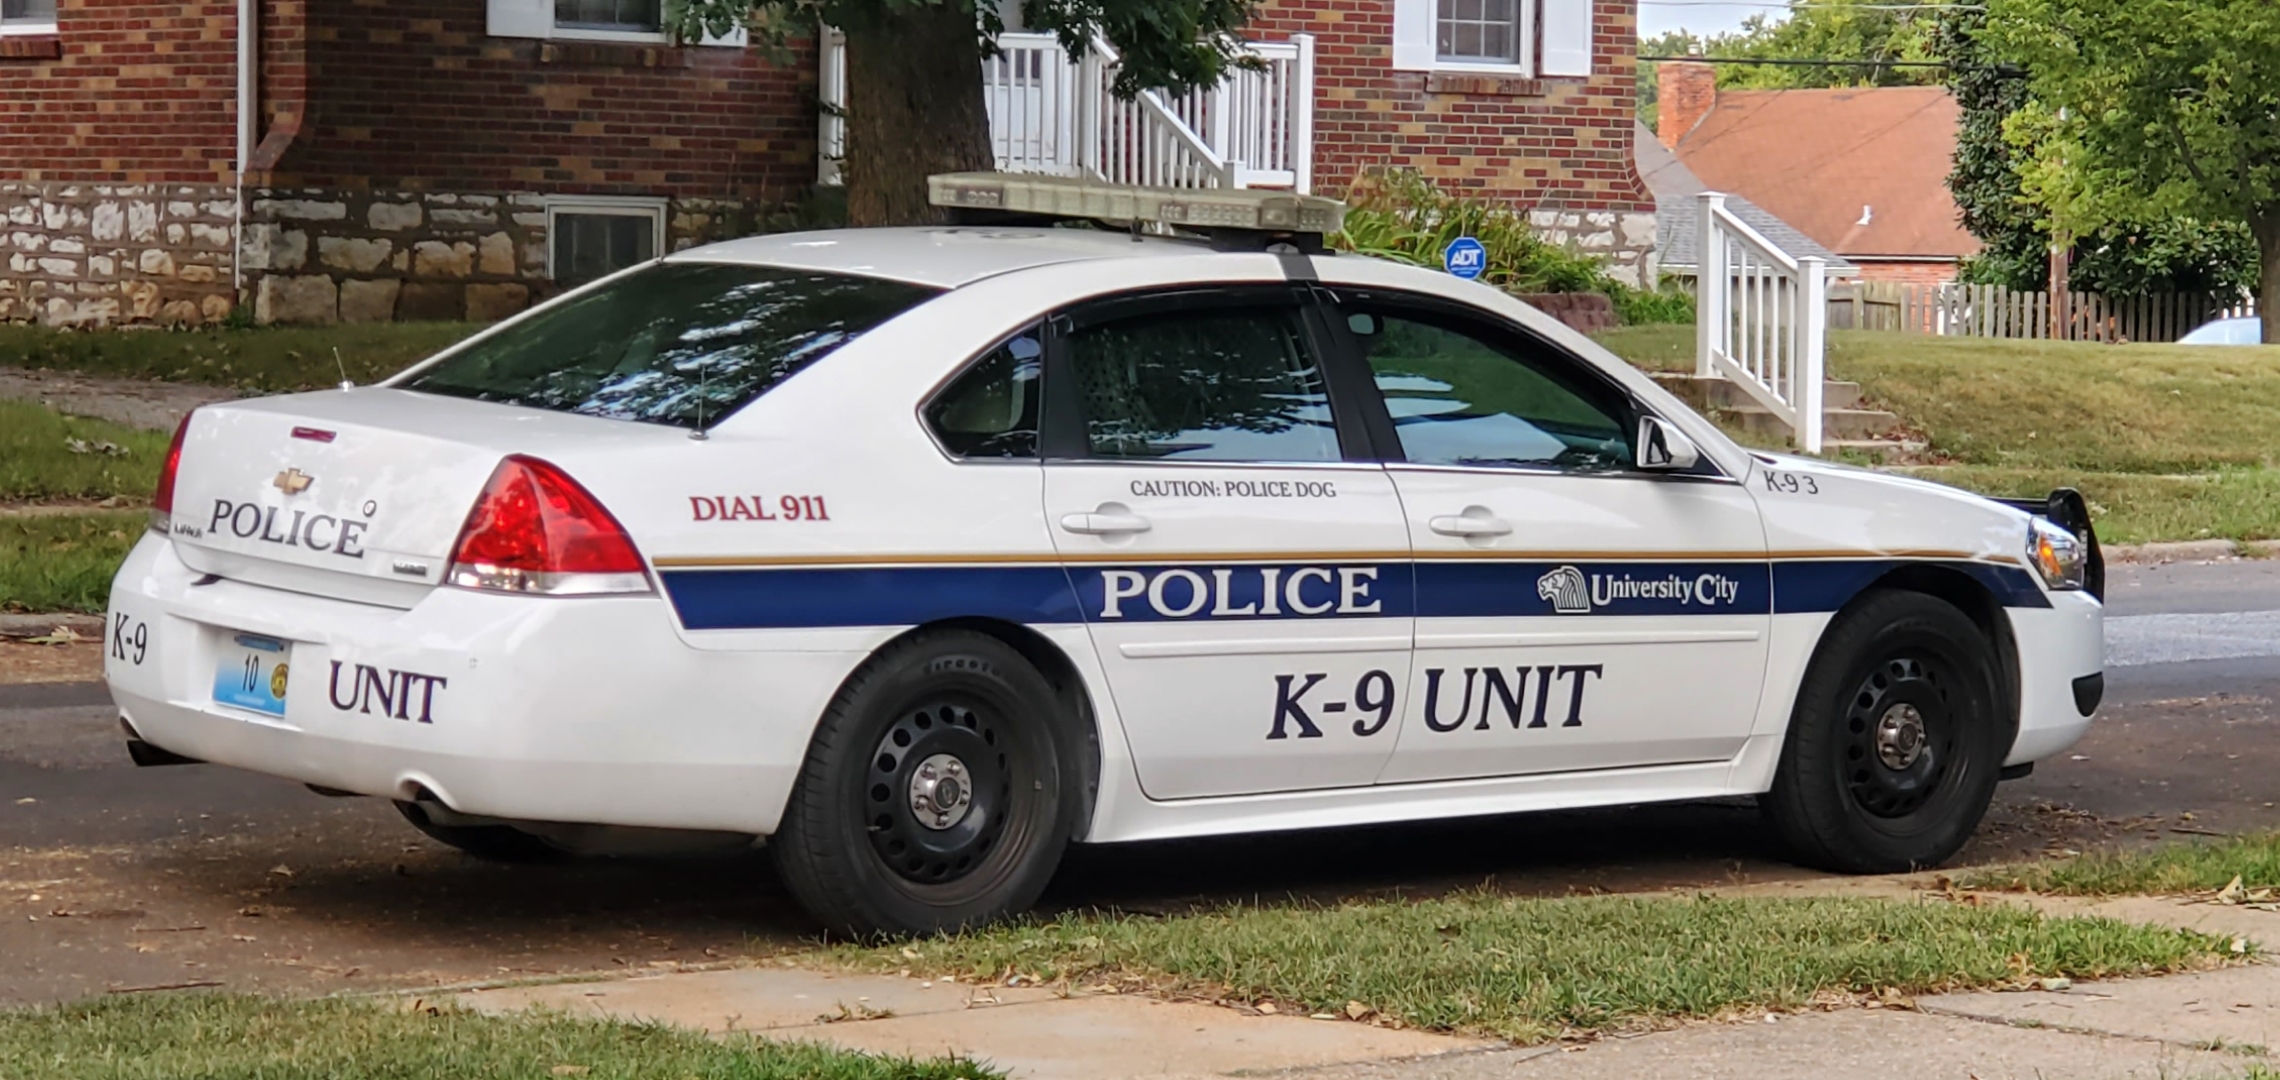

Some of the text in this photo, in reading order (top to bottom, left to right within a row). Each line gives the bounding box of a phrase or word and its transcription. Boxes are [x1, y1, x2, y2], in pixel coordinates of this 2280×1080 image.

[1450, 248, 1482, 267] ADT
[1130, 480, 1337, 498] CAUTION: POLICE DOG
[1763, 470, 1819, 495] K-9 3
[688, 494, 831, 521] DIAL 911
[207, 498, 368, 559] POLICE
[1099, 566, 1381, 618] POLICE
[1591, 573, 1739, 606] University City
[112, 611, 147, 666] K-9
[242, 653, 260, 693] 10
[329, 658, 448, 724] UNIT
[1265, 663, 1604, 740] K-9 UNIT
